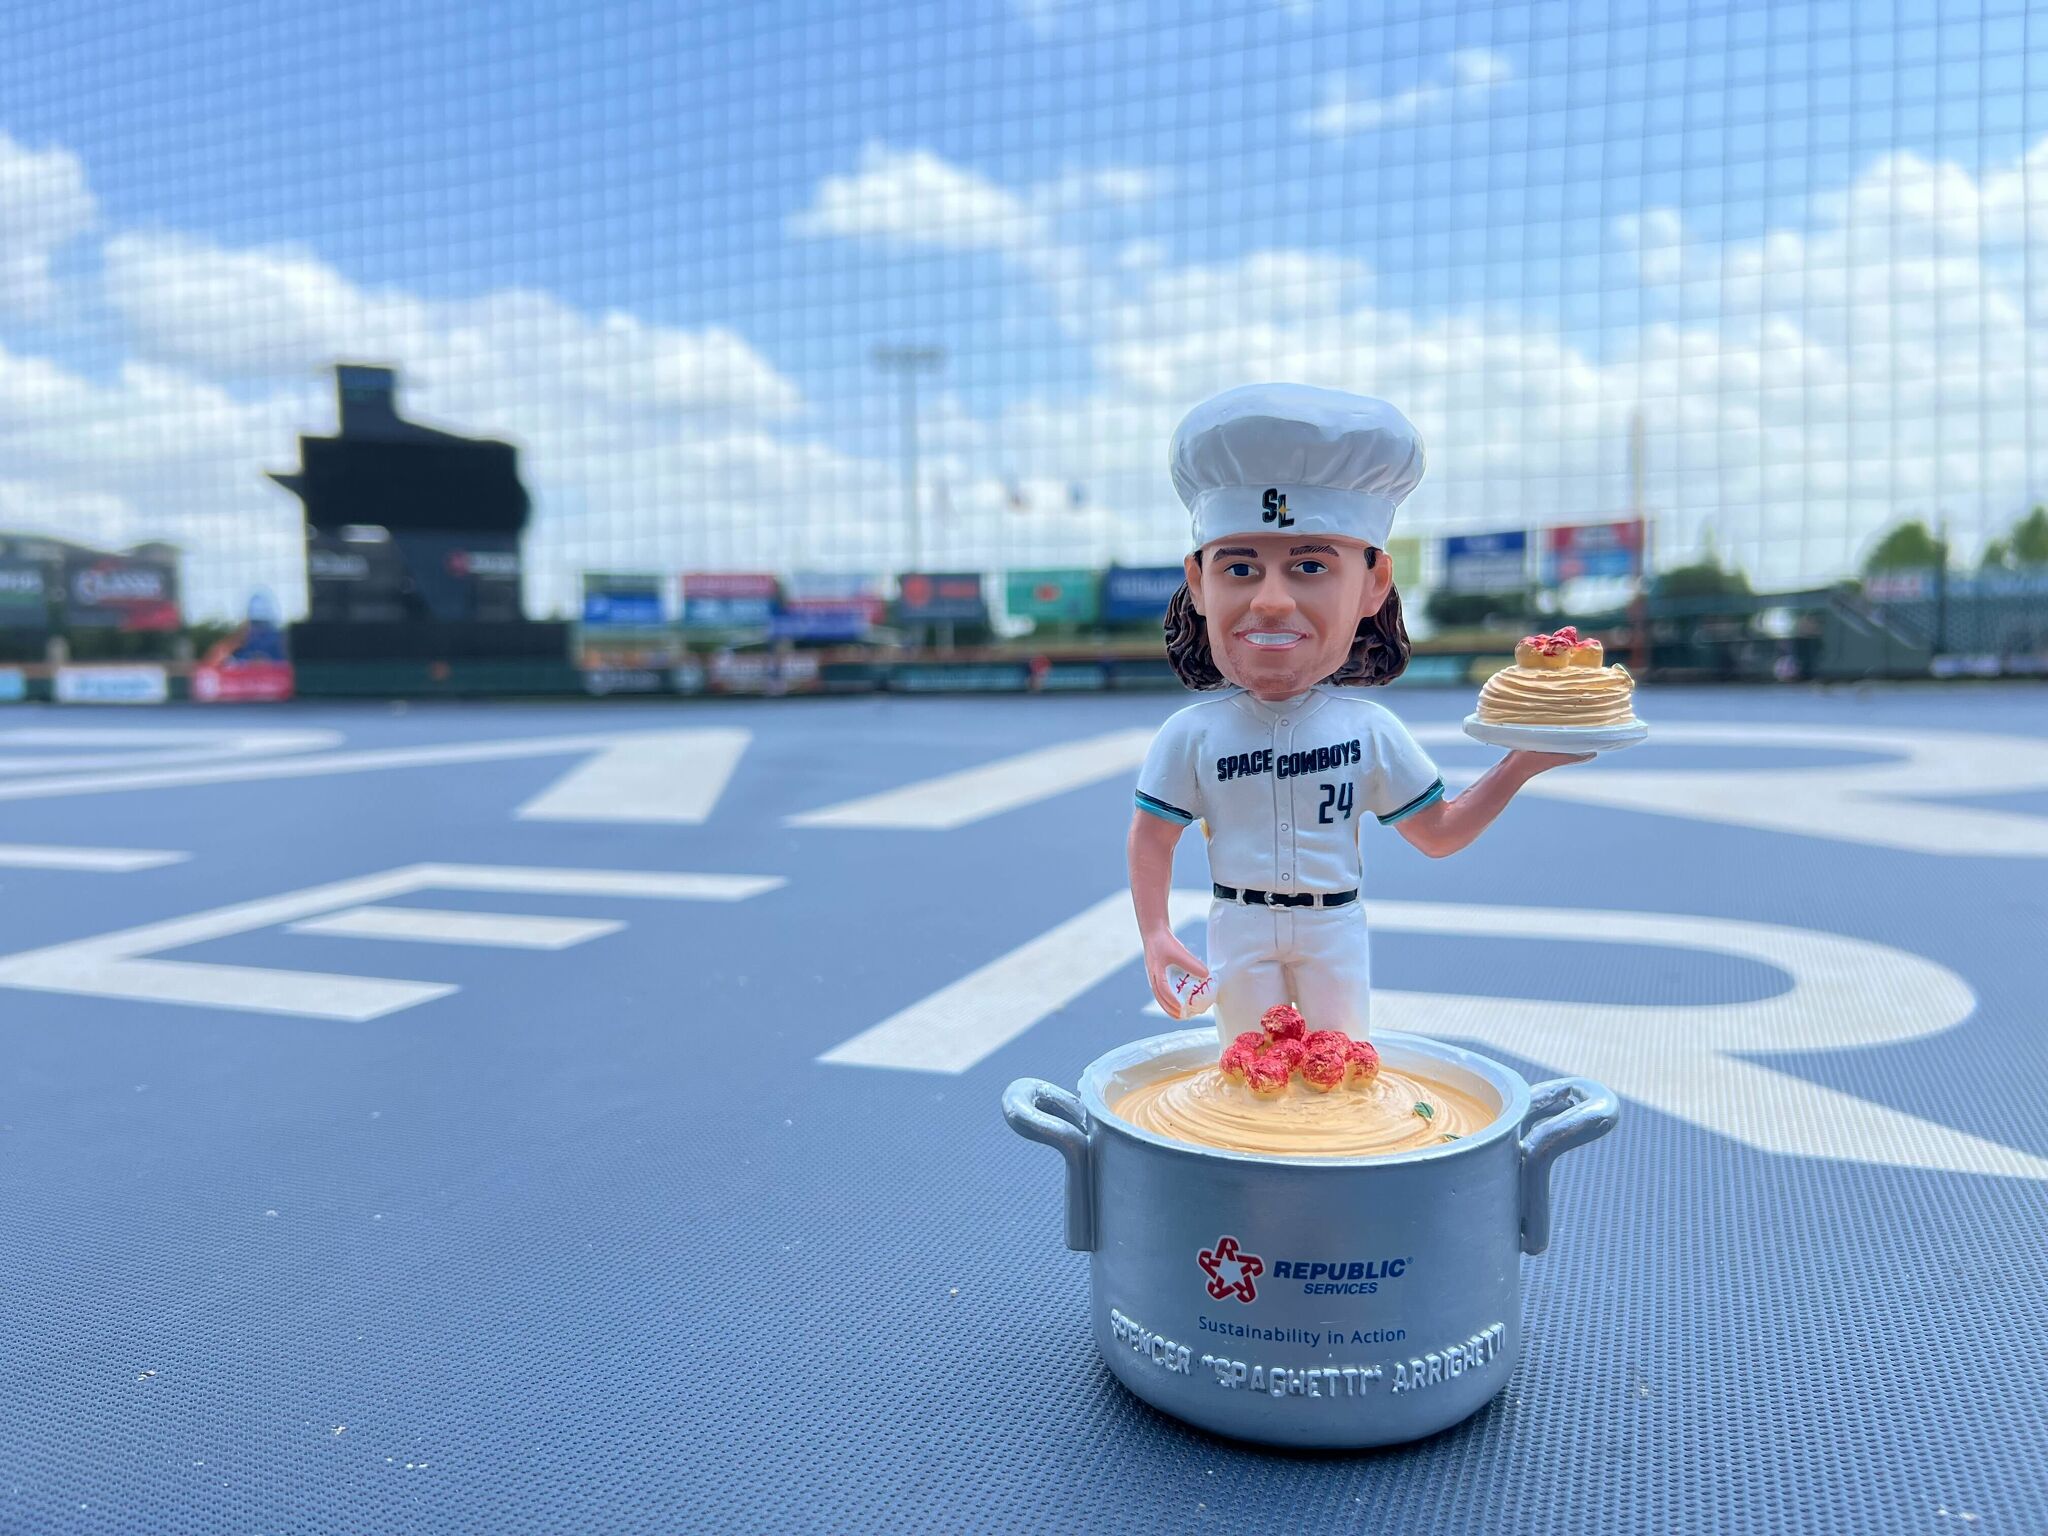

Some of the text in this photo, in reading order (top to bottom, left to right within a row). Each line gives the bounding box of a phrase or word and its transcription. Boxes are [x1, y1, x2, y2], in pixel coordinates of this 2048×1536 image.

[1261, 488, 1295, 529] SL
[1216, 739, 1361, 782] SPACE COWBOYS
[1318, 782, 1354, 825] 24
[1303, 1281, 1379, 1296] SERVICES
[1110, 1307, 1192, 1376] SPENCER
[1391, 1321, 1507, 1395] ARRIGHETTI
[1199, 1315, 1406, 1347] Sustainability in Action
